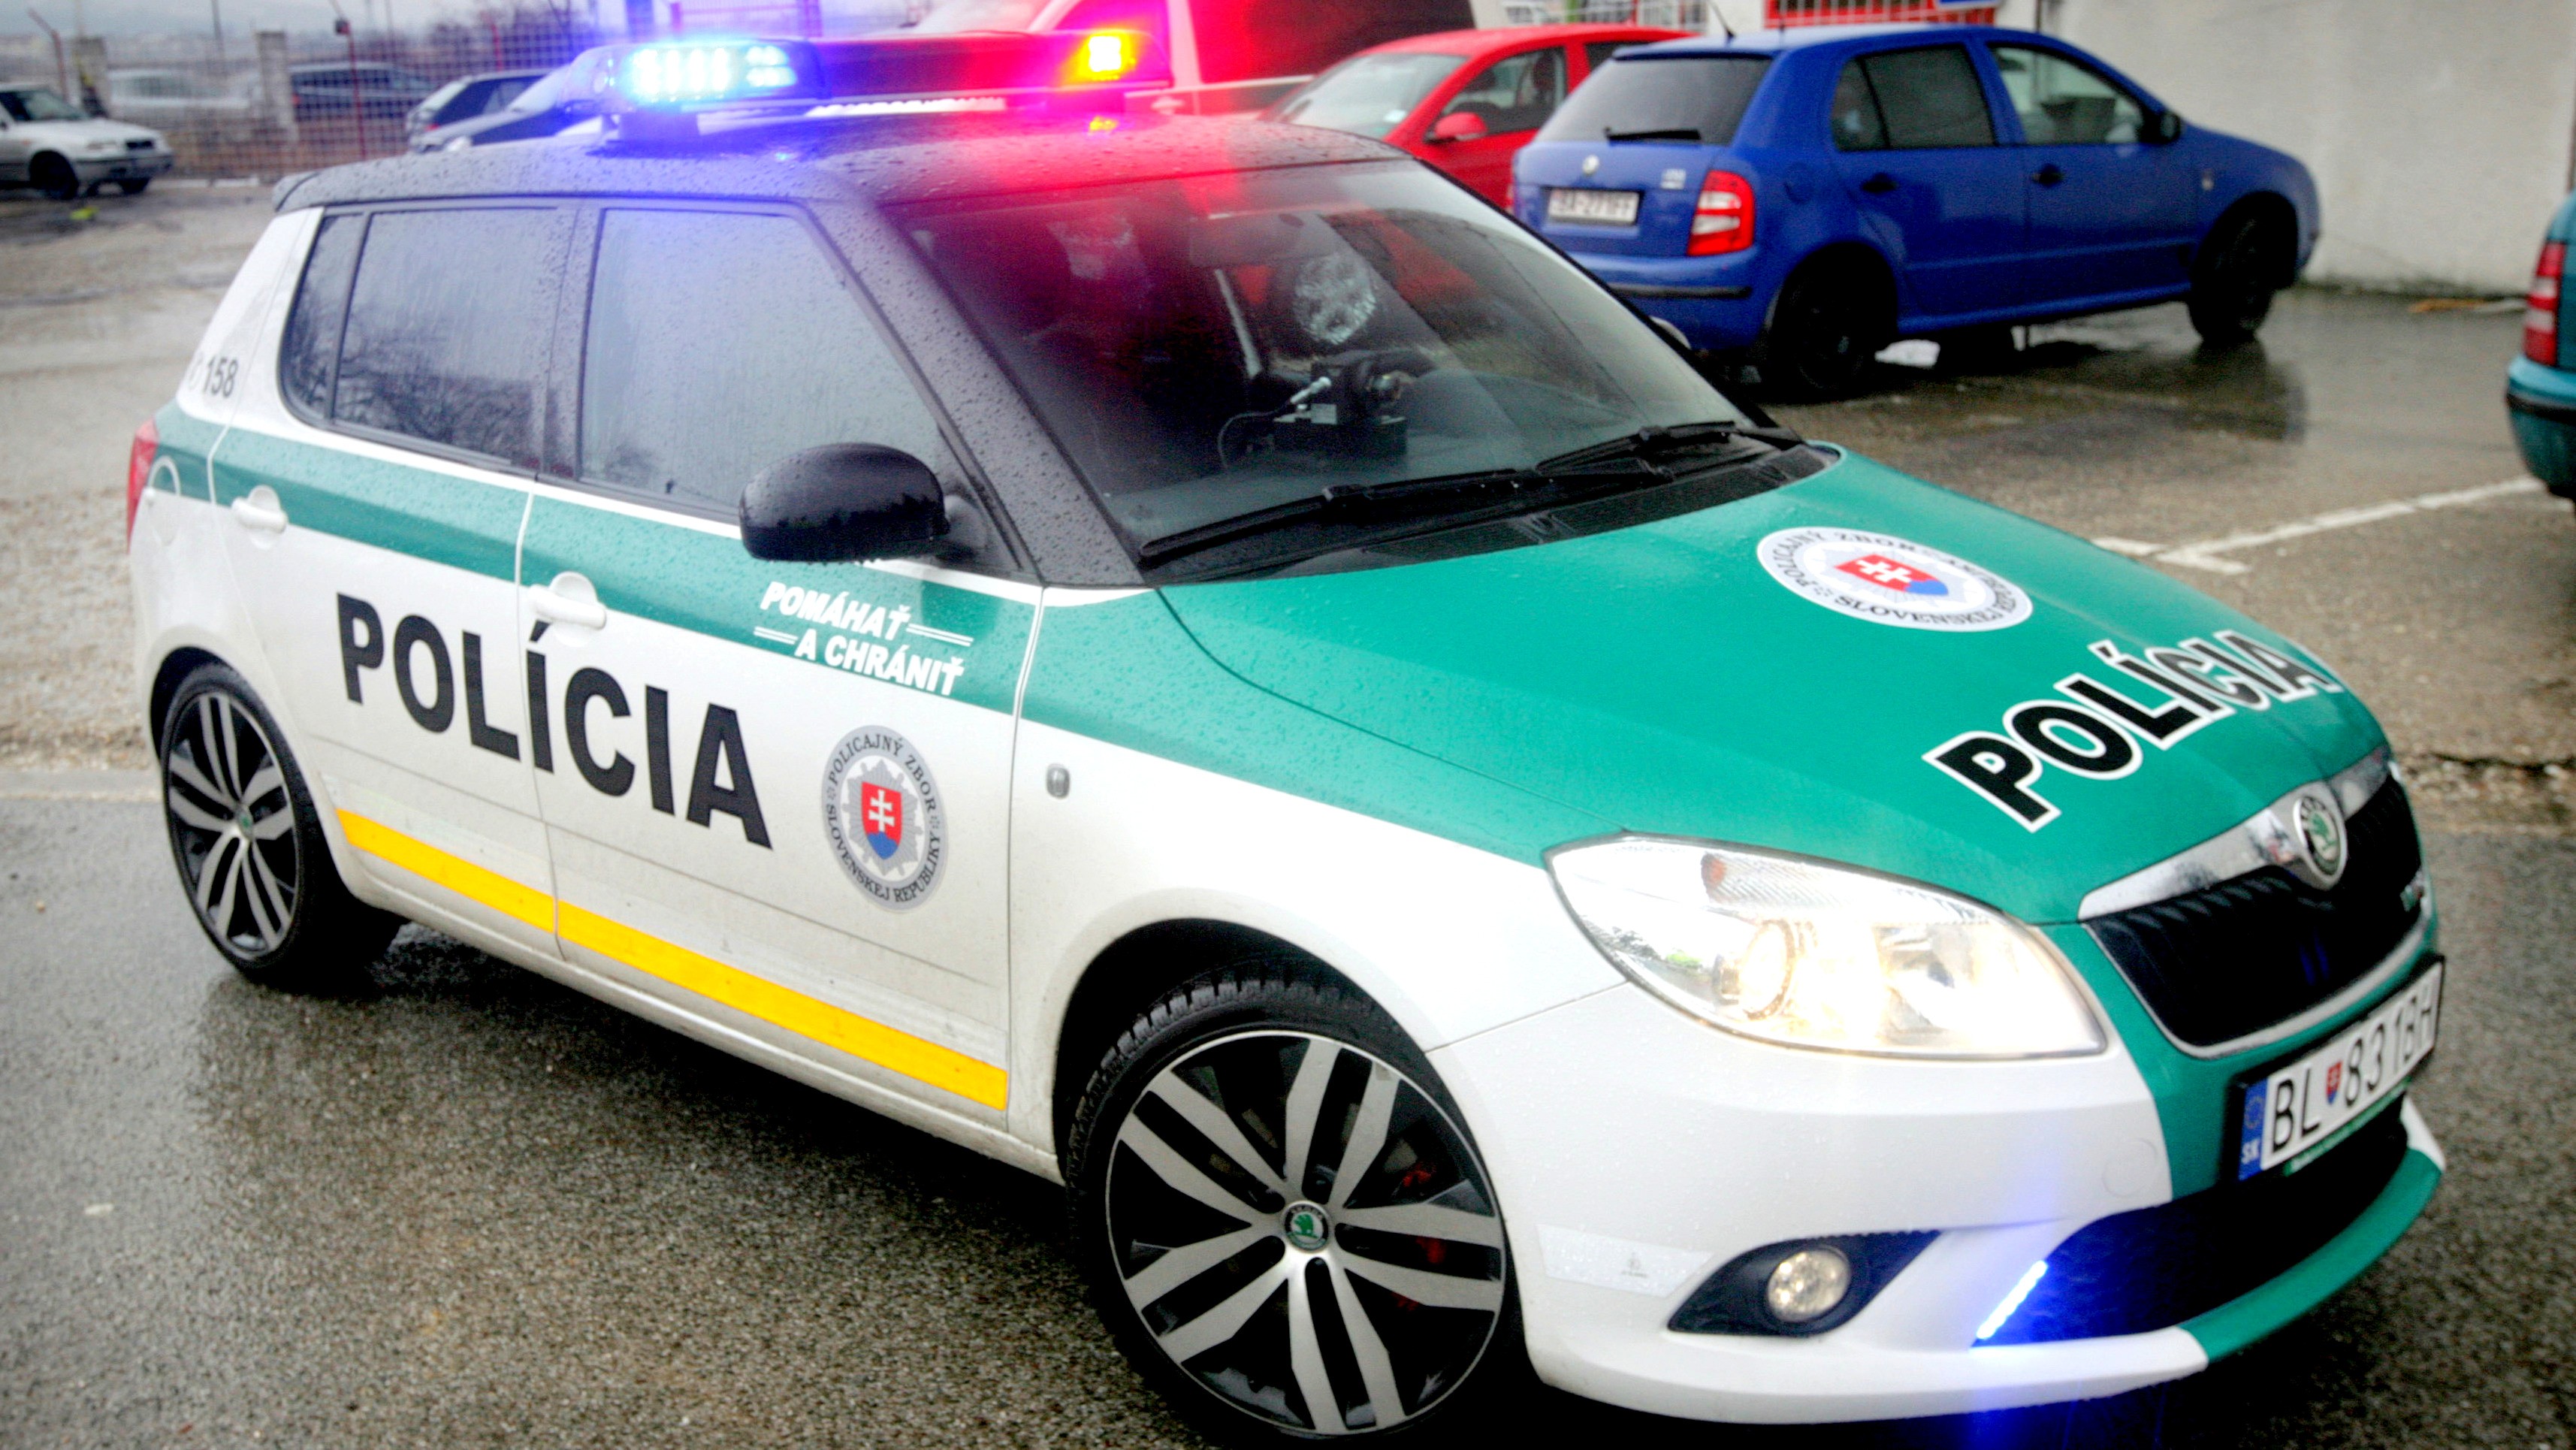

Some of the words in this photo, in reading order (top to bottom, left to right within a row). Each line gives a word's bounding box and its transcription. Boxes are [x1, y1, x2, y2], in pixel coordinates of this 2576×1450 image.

[203, 355, 239, 398] 158
[760, 581, 912, 641] POMÁHAŤ
[793, 628, 818, 661] A
[823, 635, 965, 696] CHRÁNIŤ
[337, 592, 773, 850] POLÍCIA
[1923, 630, 2340, 831] POLÍCIA
[828, 733, 905, 787] POLICAJNÝ
[904, 754, 937, 812] ZBOR
[825, 803, 890, 901] SLOVENSKEJ
[892, 831, 941, 903] REPUBLIKY
[2272, 1067, 2321, 1154] BL
[2241, 1137, 2261, 1166] SK
